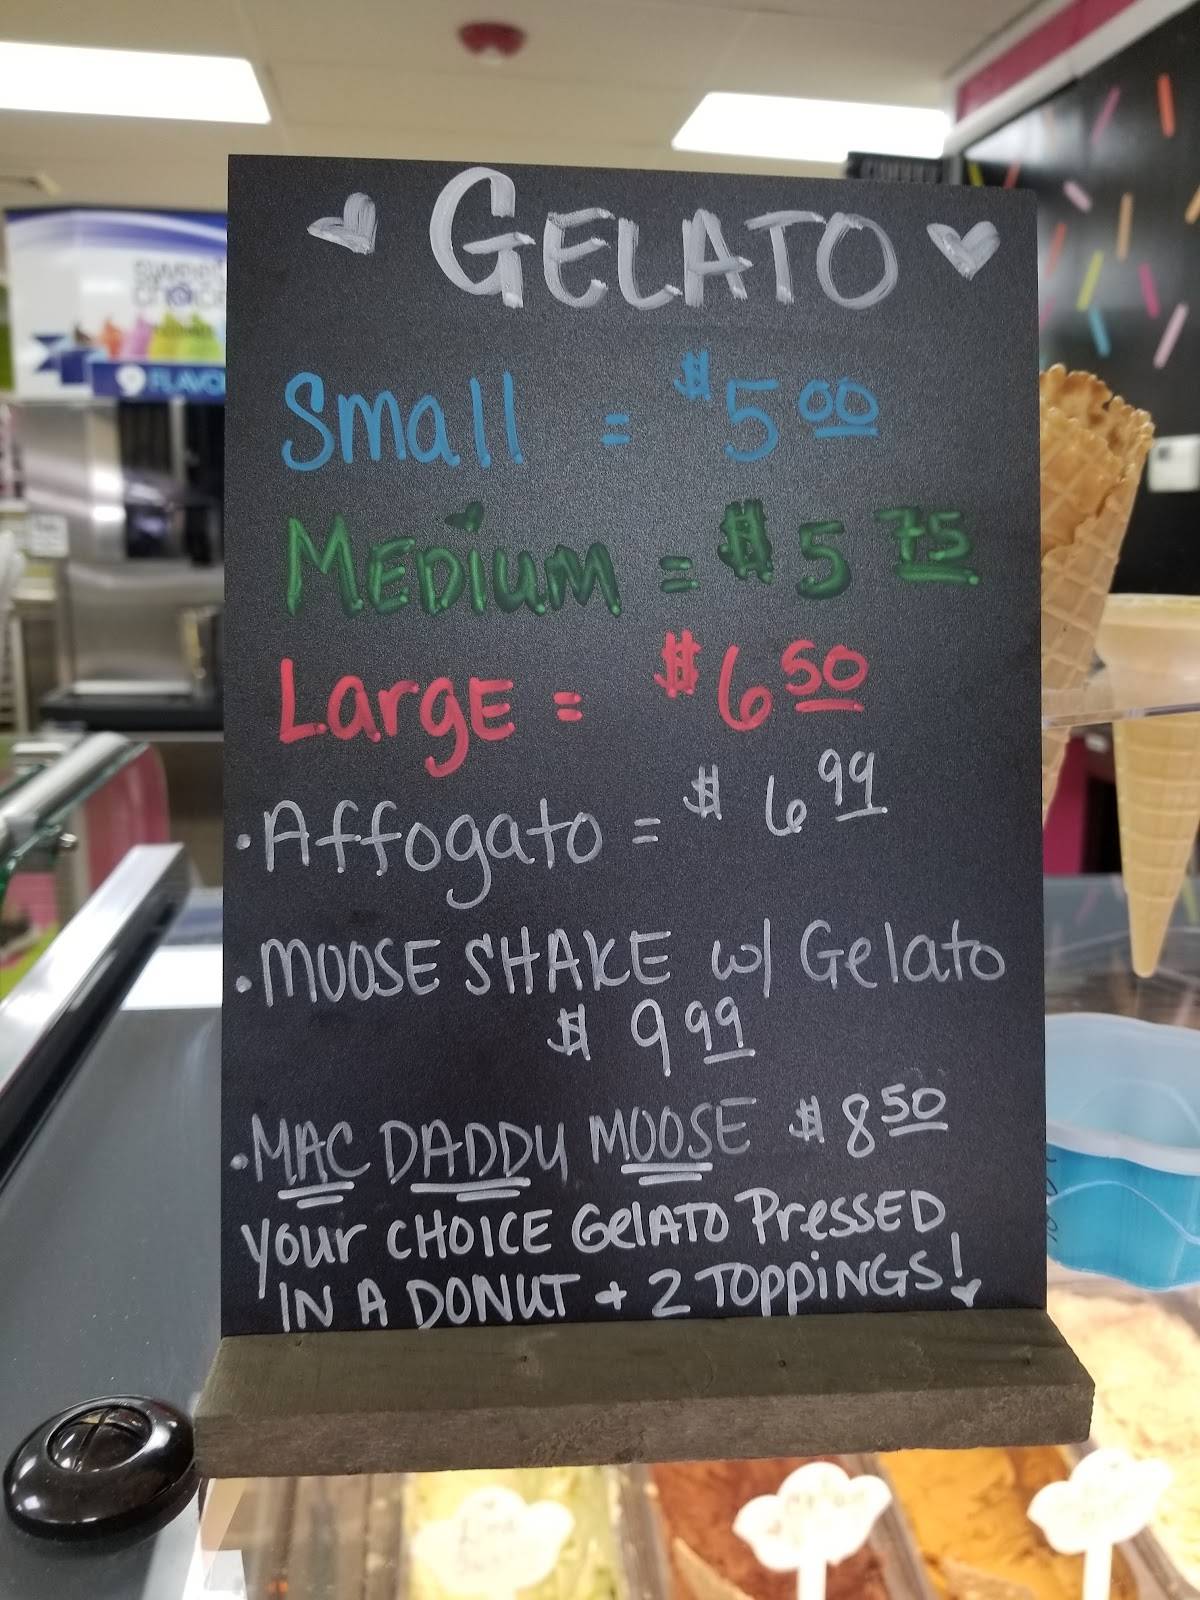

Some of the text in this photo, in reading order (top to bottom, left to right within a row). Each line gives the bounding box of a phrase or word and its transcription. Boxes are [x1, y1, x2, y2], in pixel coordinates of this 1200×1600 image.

[429, 167, 899, 309] GELATO
[281, 371, 525, 473] Small
[263, 796, 603, 909] Affogato
[260, 917, 1006, 1007] MOOSE SHAKE w/ Gelato
[252, 1114, 371, 1188] MAC
[379, 1119, 569, 1187] DADDY
[589, 1097, 757, 1162] MOOSE
[386, 1208, 554, 1260] CHOICE
[278, 1281, 335, 1333] IN
[356, 1277, 389, 1327] A
[405, 1273, 581, 1330] DONUT
[648, 1268, 692, 1318] 2
